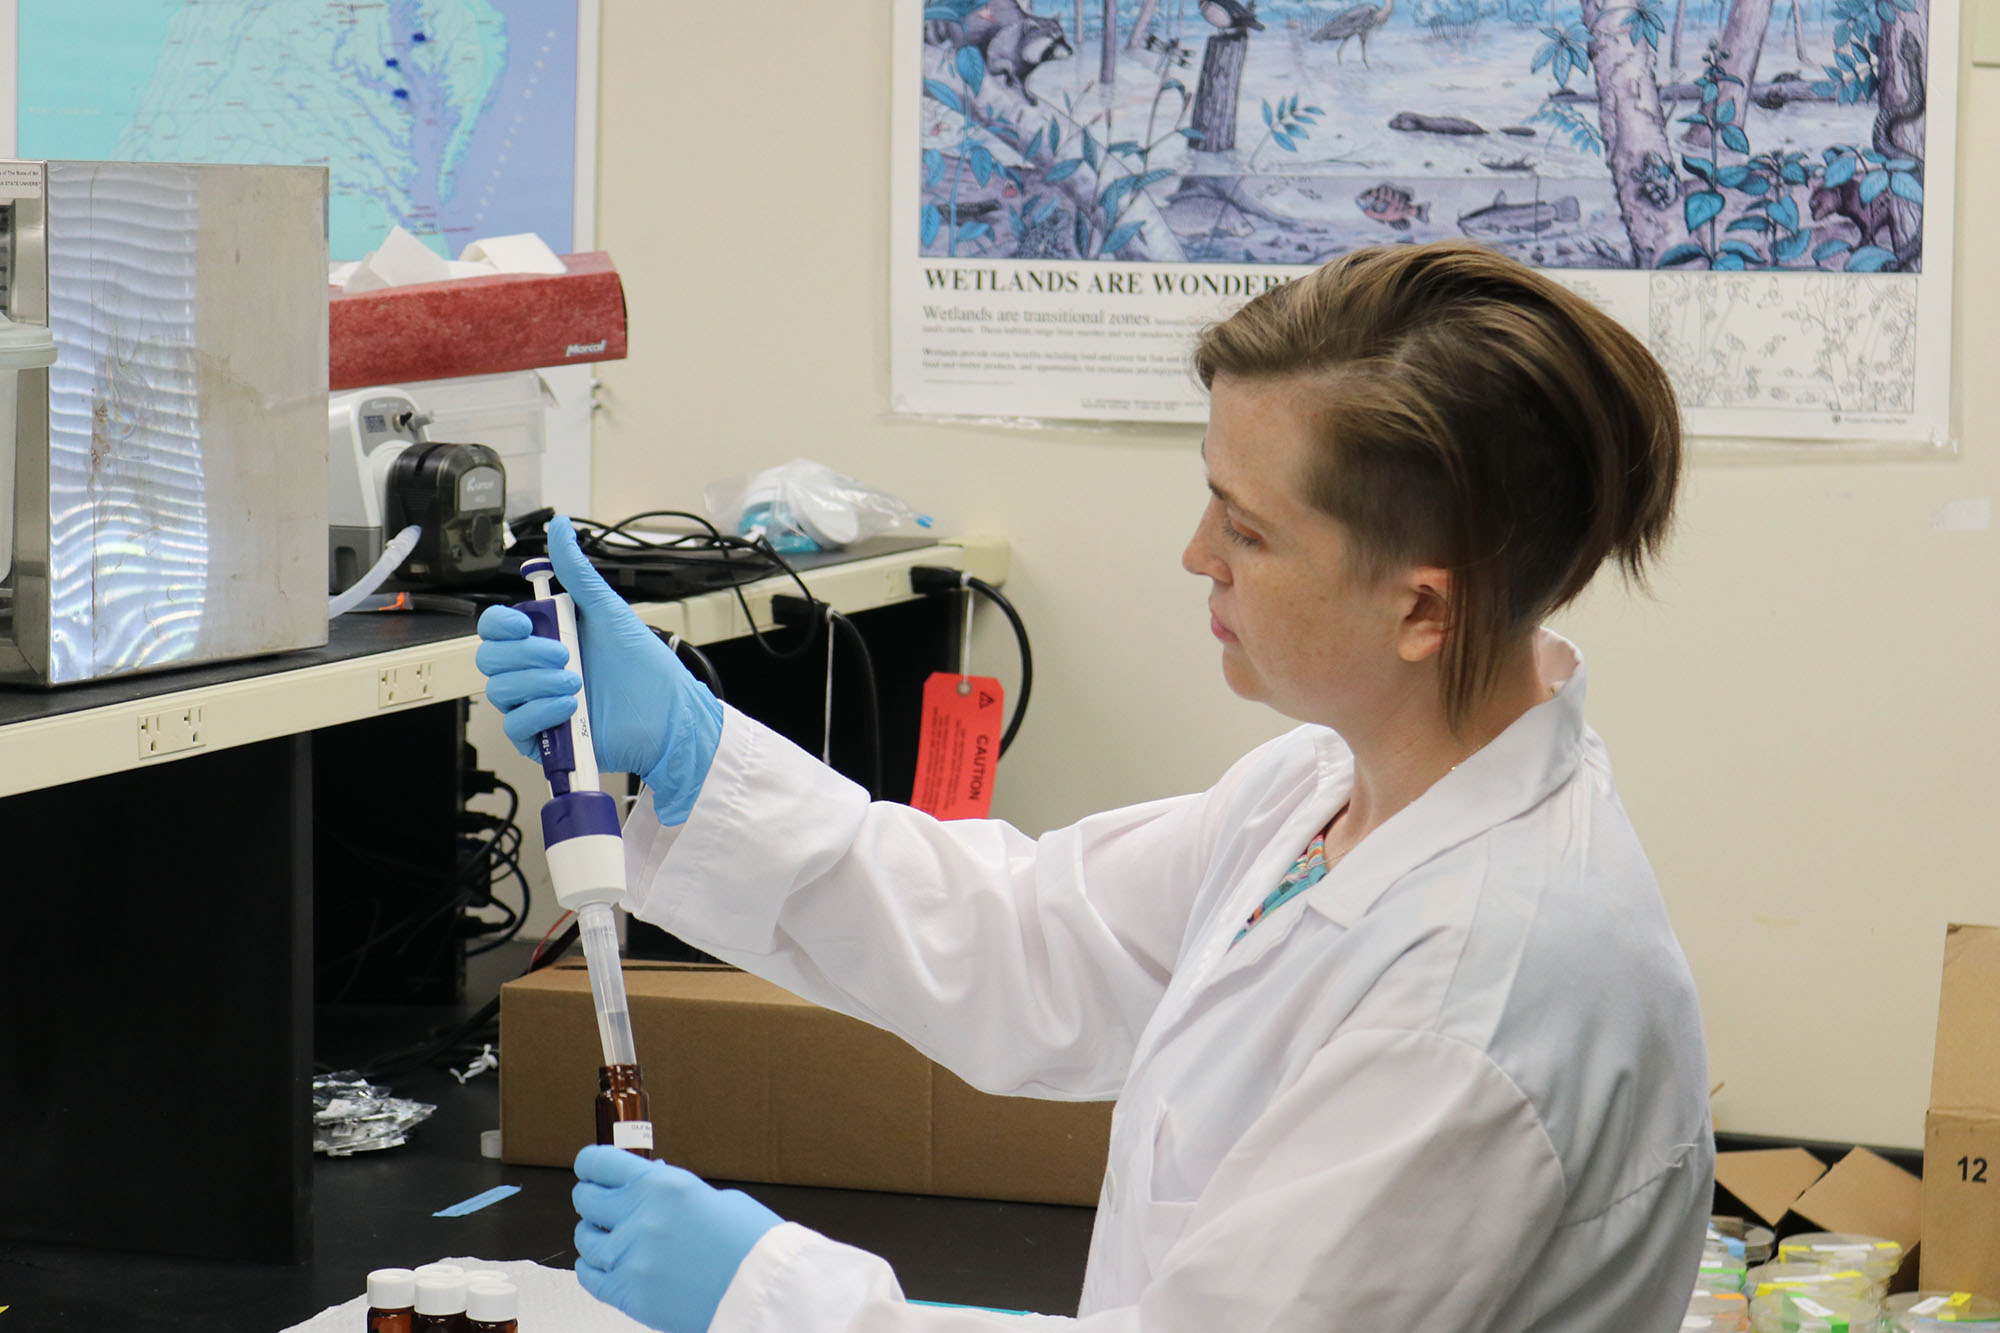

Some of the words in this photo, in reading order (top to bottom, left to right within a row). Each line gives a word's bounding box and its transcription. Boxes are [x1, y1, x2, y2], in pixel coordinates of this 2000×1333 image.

[924, 269, 1079, 293] WETLANDS
[1088, 271, 1144, 294] ARE
[923, 305, 992, 322] Wetlands
[997, 310, 1019, 322] are
[1024, 309, 1104, 324] transitional
[1109, 313, 1150, 325] zones
[541, 739, 551, 756] 1-10
[969, 735, 988, 801] CAUTION
[1957, 1155, 1988, 1183] 12
